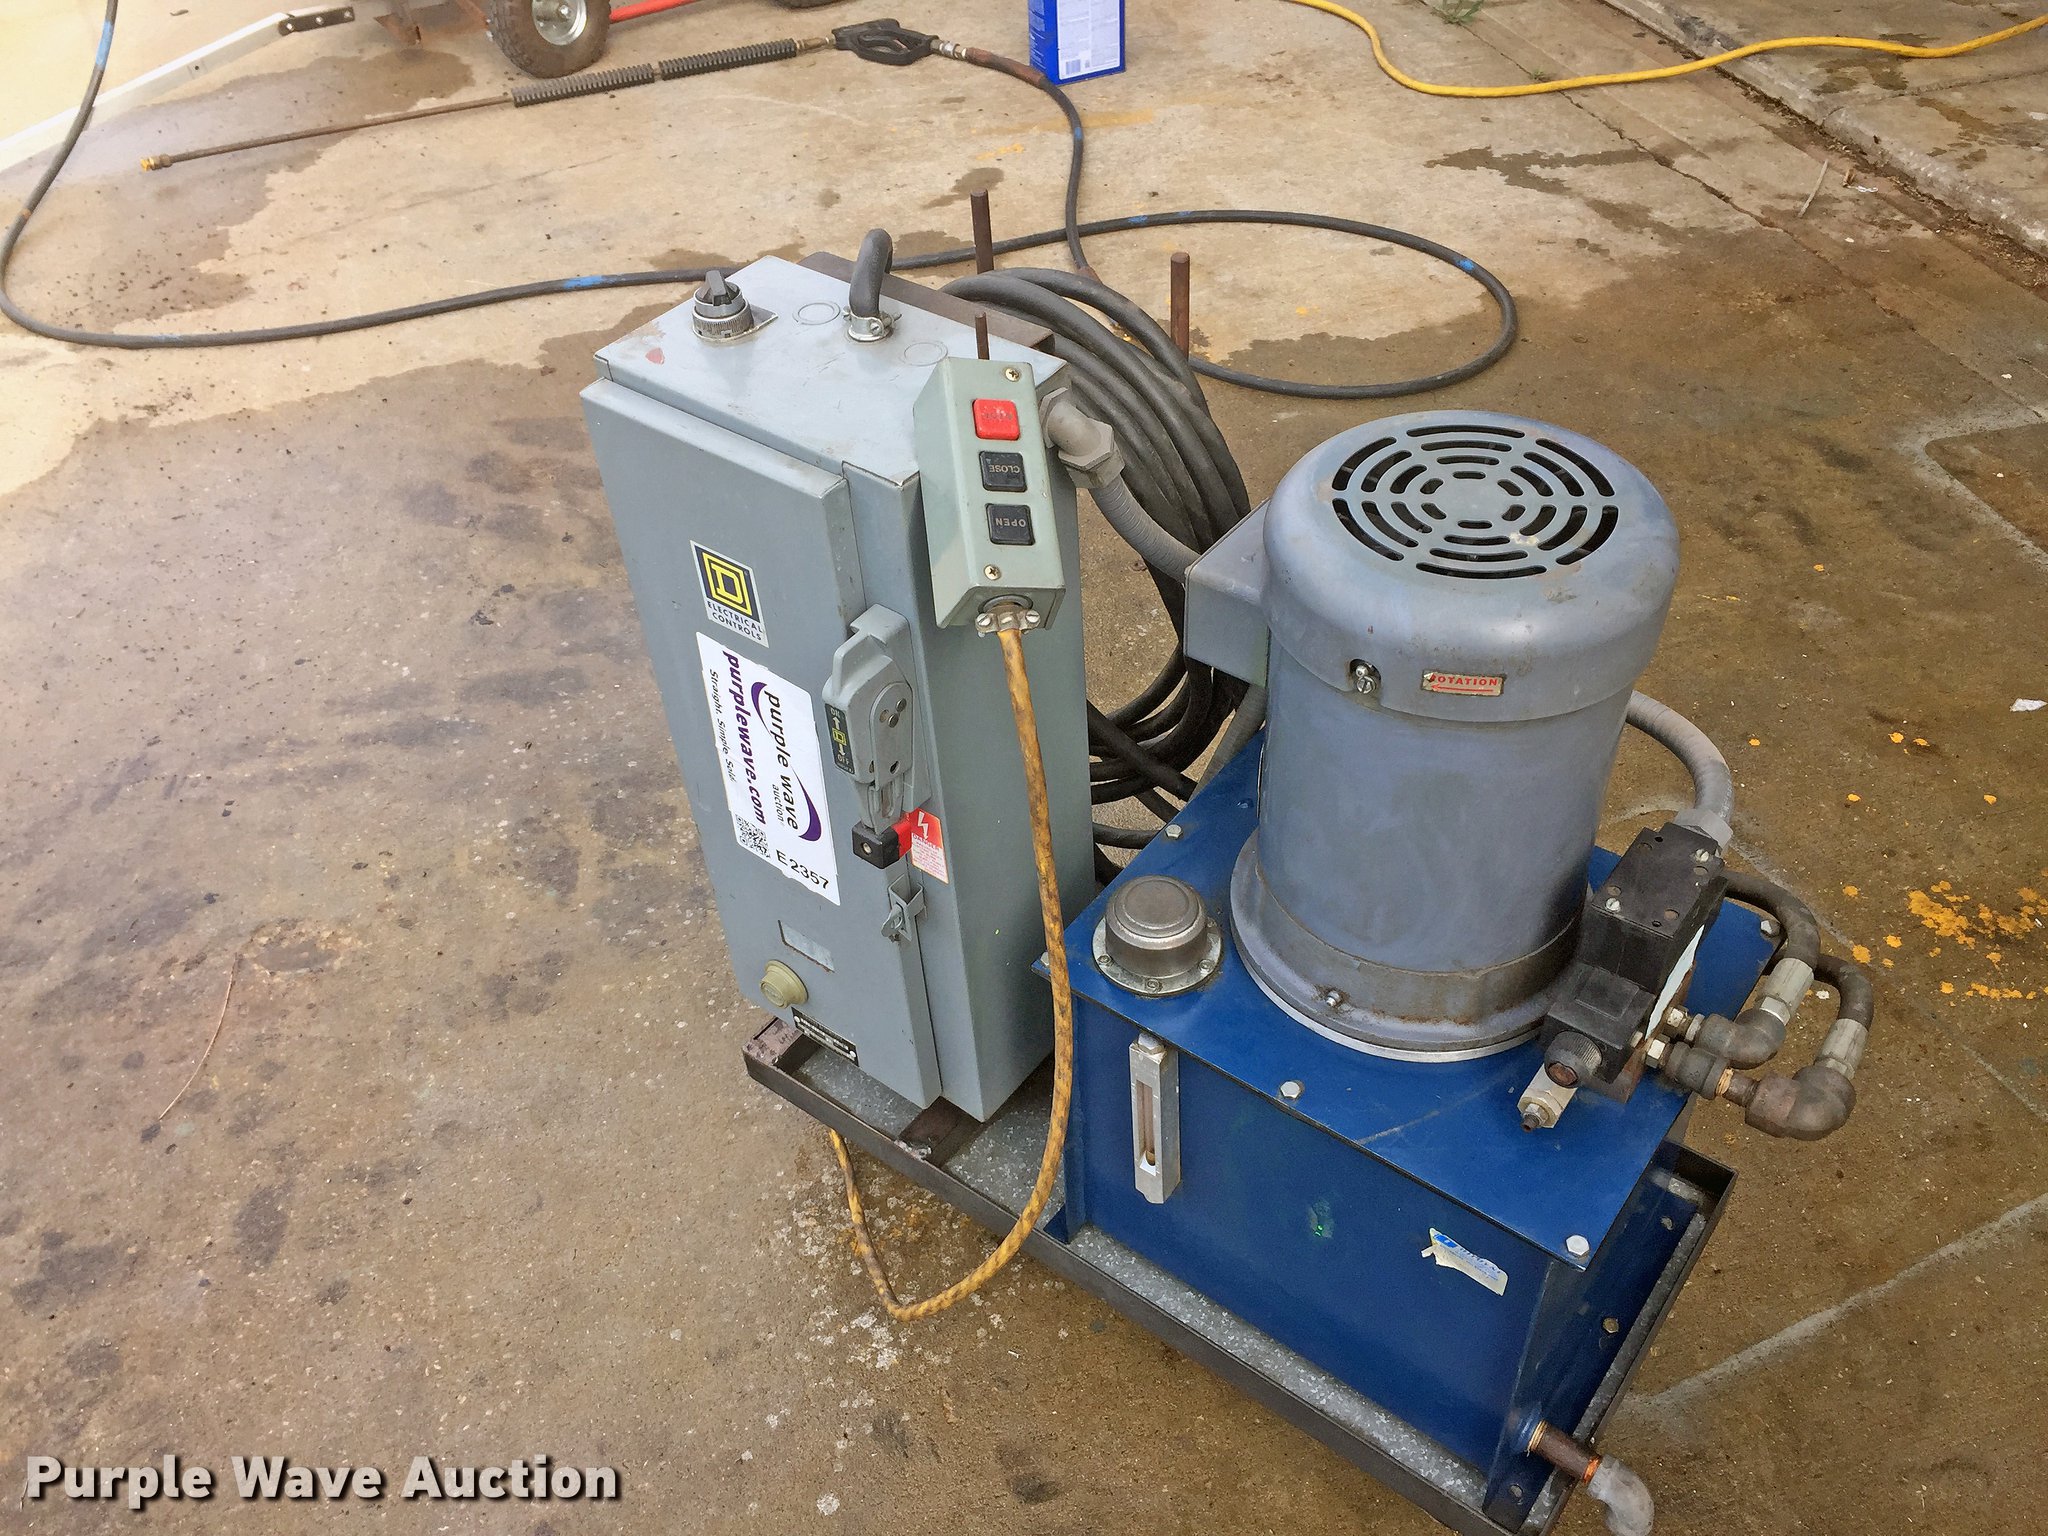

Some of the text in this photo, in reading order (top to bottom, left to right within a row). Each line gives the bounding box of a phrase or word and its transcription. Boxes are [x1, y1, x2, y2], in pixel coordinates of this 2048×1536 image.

[989, 464, 1020, 474] CLOSE
[995, 518, 1027, 528] OPEN
[707, 600, 763, 633] ELECTRICAL
[712, 612, 762, 641] CONTROLS
[722, 650, 767, 825] purplewave.com
[764, 690, 799, 830] purple wave
